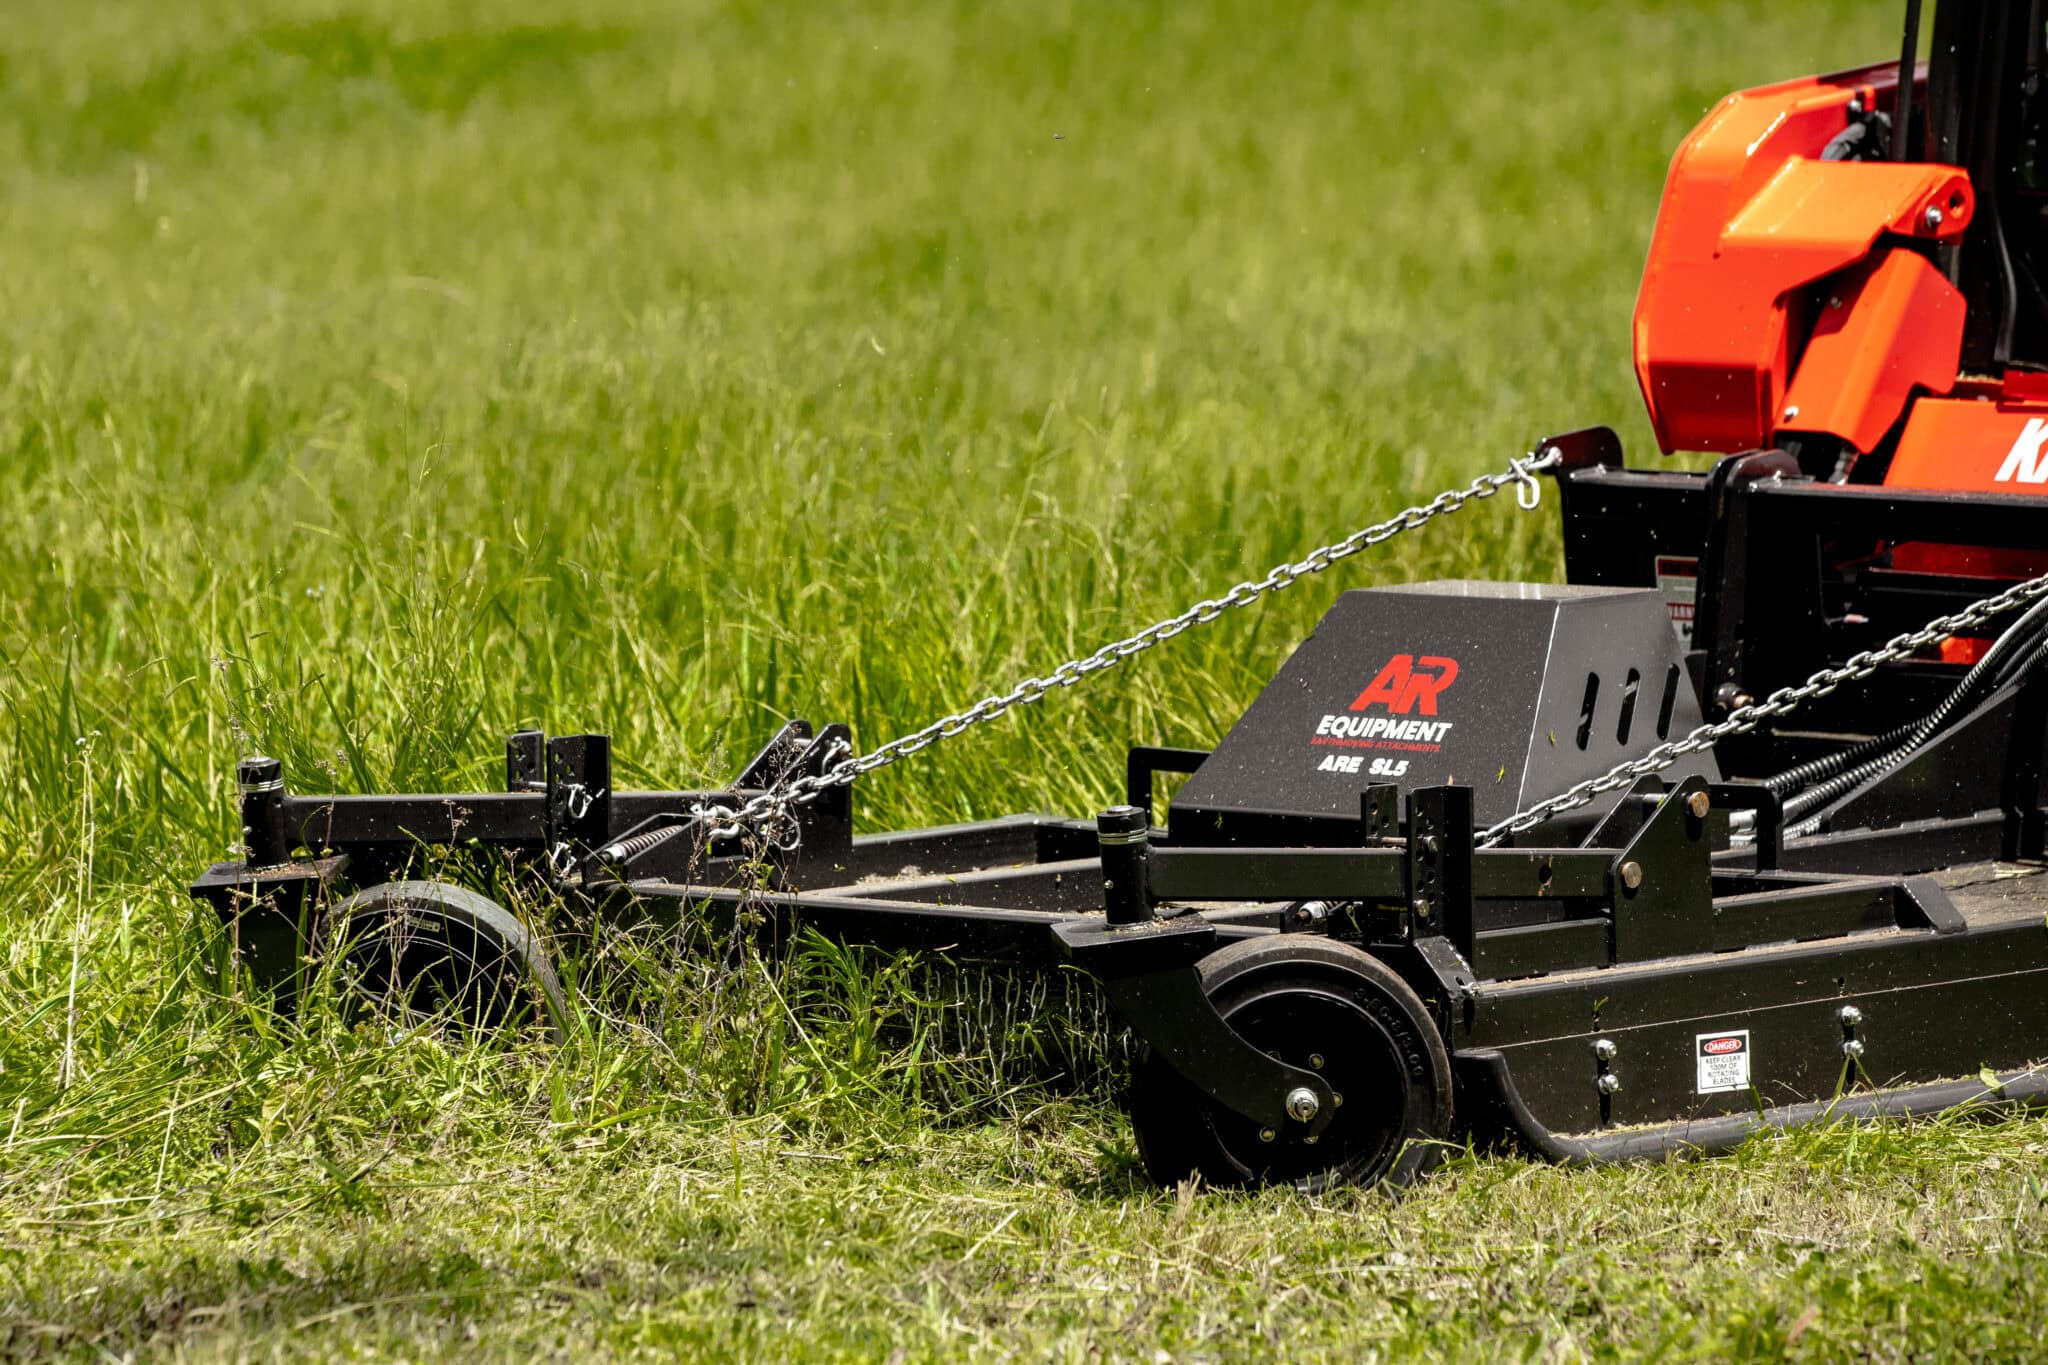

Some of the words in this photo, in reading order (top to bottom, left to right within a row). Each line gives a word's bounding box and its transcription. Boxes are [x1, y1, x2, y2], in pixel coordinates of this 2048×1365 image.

[1994, 418, 2048, 484] K
[1349, 654, 1459, 715] AR
[1316, 715, 1452, 742] EQUIPMENT
[1310, 737, 1374, 748] EARTHMOVING
[1375, 741, 1441, 752] ATTACHMENTS
[1317, 755, 1364, 773] ARE
[1369, 758, 1409, 776] SL5
[1709, 1040, 1737, 1051] DANGER
[1721, 1055, 1741, 1063] CLEAR
[1728, 1062, 1737, 1070] OF
[1707, 1069, 1740, 1078] ROTATING
[1713, 1077, 1736, 1085] BLADES
